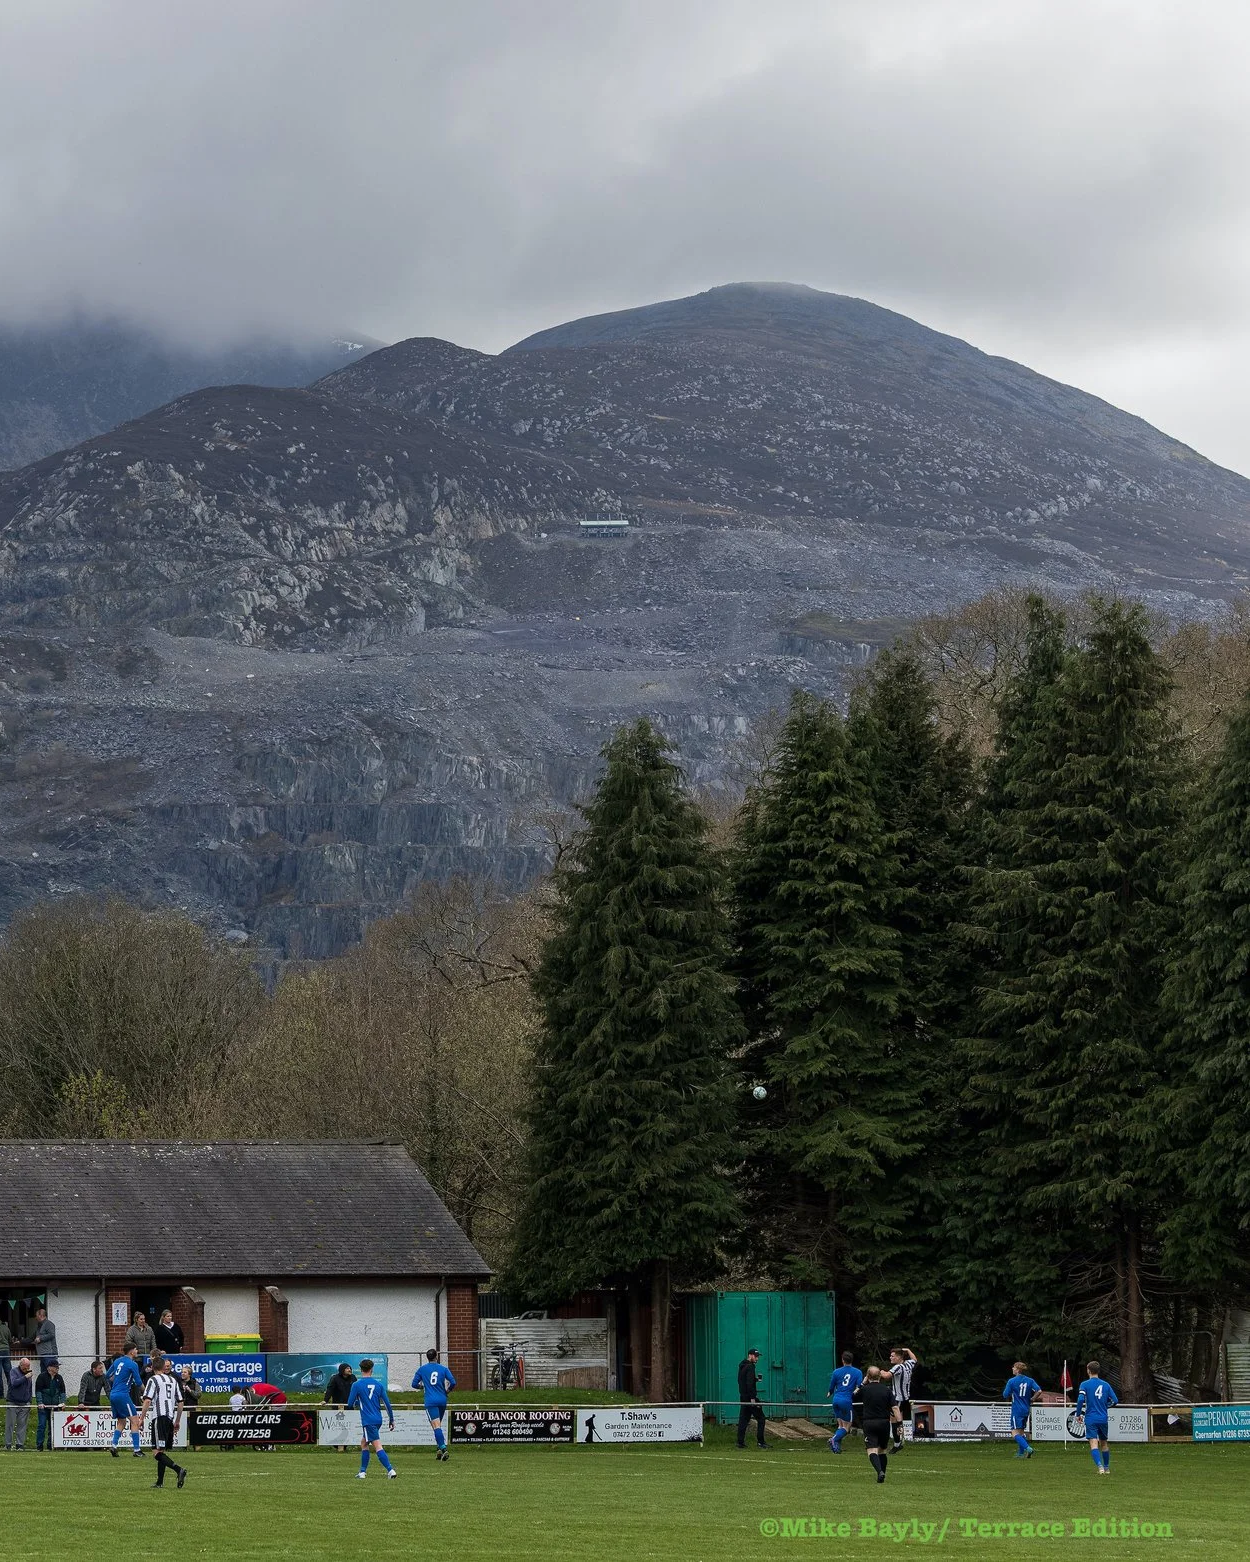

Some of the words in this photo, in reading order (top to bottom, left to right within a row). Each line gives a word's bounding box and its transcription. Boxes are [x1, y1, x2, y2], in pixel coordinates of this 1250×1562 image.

[115, 1362, 124, 1375] 5
[215, 1360, 263, 1375] Garage
[430, 1371, 438, 1385] 6
[842, 1374, 851, 1386] 3
[165, 1383, 172, 1399] 6
[205, 1385, 231, 1393] 601031
[367, 1384, 375, 1399] 7
[1019, 1382, 1027, 1397] 11
[1094, 1385, 1103, 1399] 4
[196, 1415, 217, 1425] CEIR
[219, 1415, 254, 1425] SEIONT
[255, 1414, 282, 1424] CARS
[454, 1411, 486, 1420] TOEAU
[488, 1411, 527, 1420] BANGOR
[529, 1411, 571, 1420] ROOFING
[620, 1411, 657, 1421] T.Shaw's
[1035, 1416, 1061, 1424] SIGNAGE
[1120, 1415, 1142, 1423] 01286
[1208, 1410, 1239, 1426] PERKINS
[96, 1420, 107, 1431] M.
[631, 1422, 672, 1430] Maintenance
[1119, 1423, 1144, 1431] 677854
[206, 1429, 234, 1439] 07378
[237, 1429, 272, 1438] 773258
